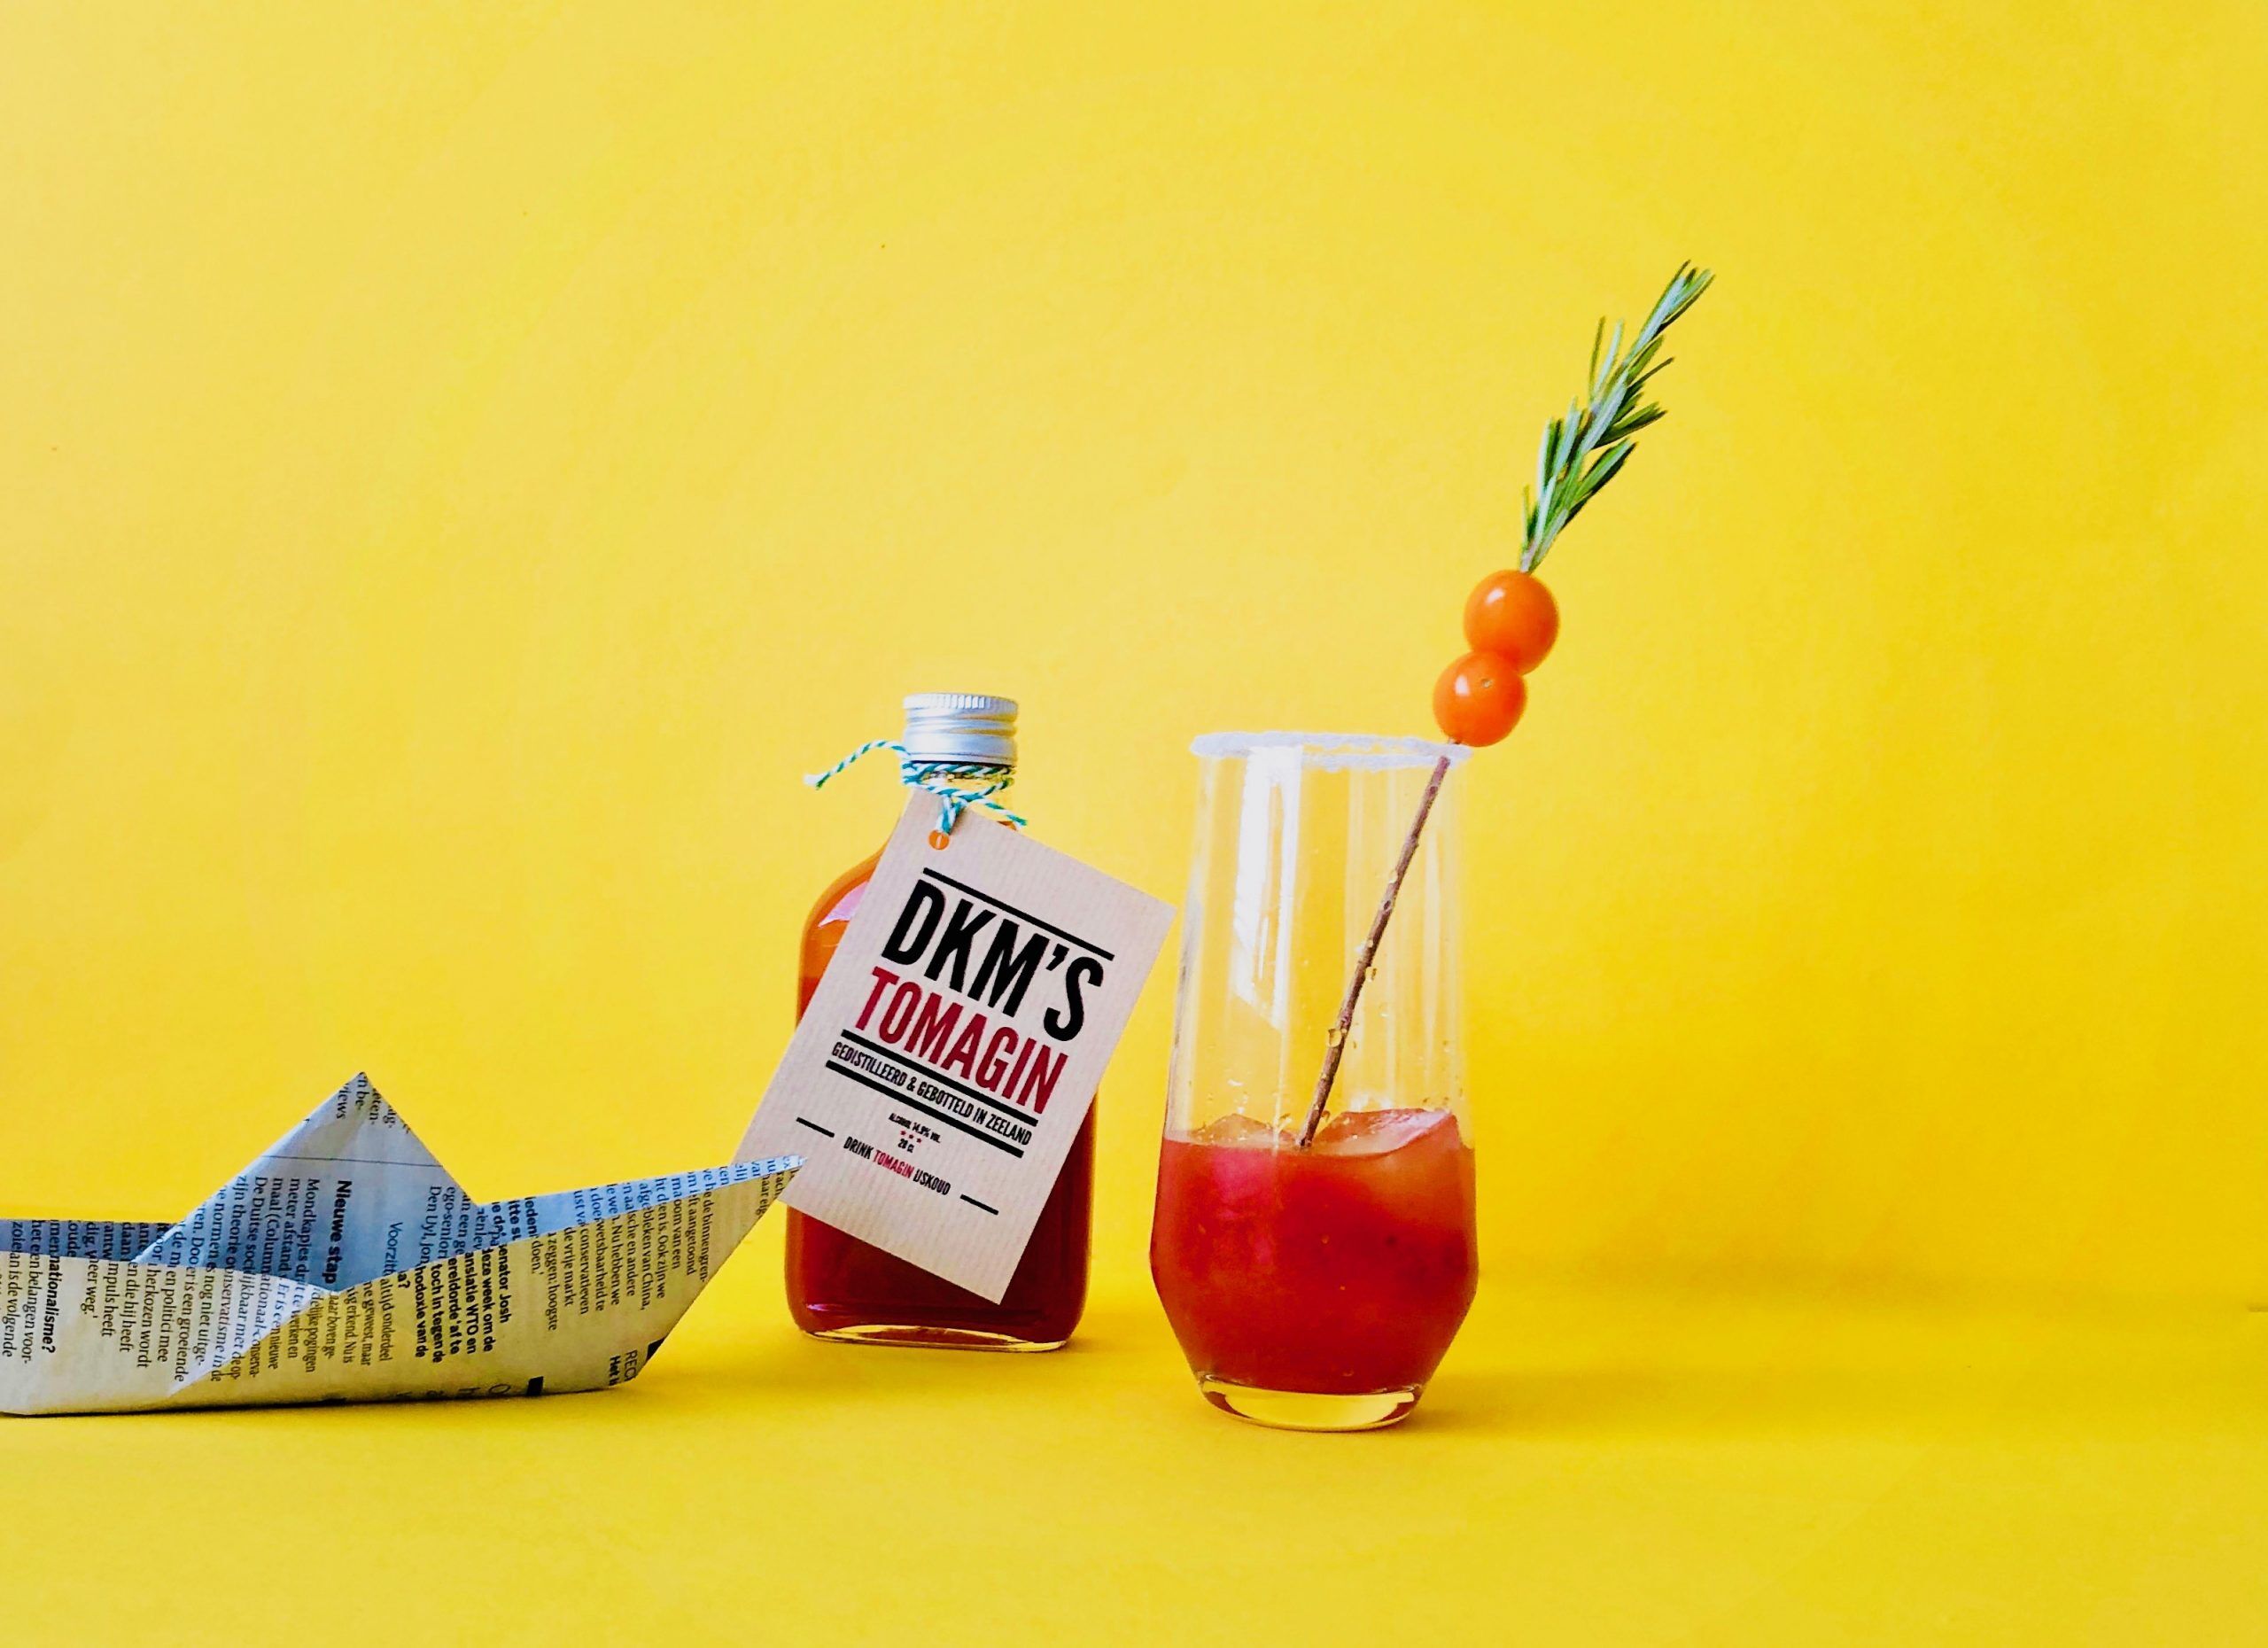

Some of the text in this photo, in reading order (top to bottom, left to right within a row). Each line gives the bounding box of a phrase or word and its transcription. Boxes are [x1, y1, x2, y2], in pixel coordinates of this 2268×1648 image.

[882, 879, 1104, 1041] DKM'S
[856, 966, 1069, 1115] TOMAGIN
[832, 1041, 1032, 1146] GEDISTILLEERD & GEBOTTELD IN ZEELAND
[843, 1136, 874, 1160] DRINK
[873, 1149, 914, 1178] TOMAGIN
[248, 1177, 268, 1241] De Duitse
[269, 1178, 284, 1211] maal
[426, 1186, 442, 1211] Den
[703, 1200, 715, 1212] de
[209, 1202, 225, 1260] normen
[227, 1175, 248, 1255] zijn theorie
[278, 1178, 301, 1271] meter afstand
[296, 1178, 321, 1264] Mondkapjes
[322, 1179, 353, 1284] Nieuwe stap
[420, 1216, 439, 1240] Uyl,
[458, 1214, 469, 1237] een
[656, 1236, 669, 1257] Ook
[673, 1226, 683, 1247] van
[685, 1209, 699, 1276] aangetoond
[698, 1214, 714, 1282] binnengren-
[9, 1271, 21, 1279] is
[561, 1227, 576, 1307] de vrije markt
[579, 1229, 591, 1315] conservatieven
[610, 1225, 623, 1305] Nu hebben we
[626, 1241, 638, 1296] en andere
[655, 1259, 669, 1282] zijn
[672, 1249, 681, 1270] een
[8, 1282, 22, 1295] de
[125, 1279, 140, 1299] die
[184, 1281, 198, 1291] is
[483, 1278, 495, 1311] week
[547, 1240, 560, 1331] zeggen: hoogste
[641, 1251, 654, 1310] van China,
[656, 1283, 665, 1299] we
[22, 1271, 43, 1328] belangen
[102, 1263, 119, 1337] mpuls heeft
[120, 1302, 138, 1318] hij
[142, 1270, 161, 1327] herkozen
[160, 1289, 175, 1333] politici
[182, 1294, 193, 1315] een
[431, 1264, 446, 1363] toch in tegen de
[499, 1294, 511, 1323] Josh
[595, 1301, 605, 1311] te
[3, 1299, 19, 1357] volgende
[193, 1271, 213, 1365] nog niet uitge-
[268, 1284, 290, 1369] Er is een nieuwe
[288, 1310, 301, 1344] werken
[346, 1306, 360, 1340] erkend.
[361, 1300, 375, 1341] geweest,
[376, 1279, 395, 1361] altijd onderdeel
[417, 1321, 427, 1343] van
[466, 1304, 478, 1335] WTO
[482, 1314, 494, 1334] om
[21, 1333, 34, 1364] voor-
[120, 1320, 135, 1352] heeft
[137, 1331, 151, 1368] wordt
[158, 1335, 170, 1362] mee
[175, 1318, 190, 1382] groeiende
[229, 1324, 245, 1380] met de op-
[287, 1347, 299, 1358] en
[303, 1329, 322, 1372] pogingen
[322, 1317, 342, 1359] boven ge-
[344, 1341, 358, 1354] Nu
[416, 1347, 429, 1357] de
[449, 1341, 462, 1354] te
[466, 1339, 477, 1354] en
[483, 1336, 495, 1351] de
[209, 1355, 226, 1382] in de
[361, 1343, 371, 1365] maar
